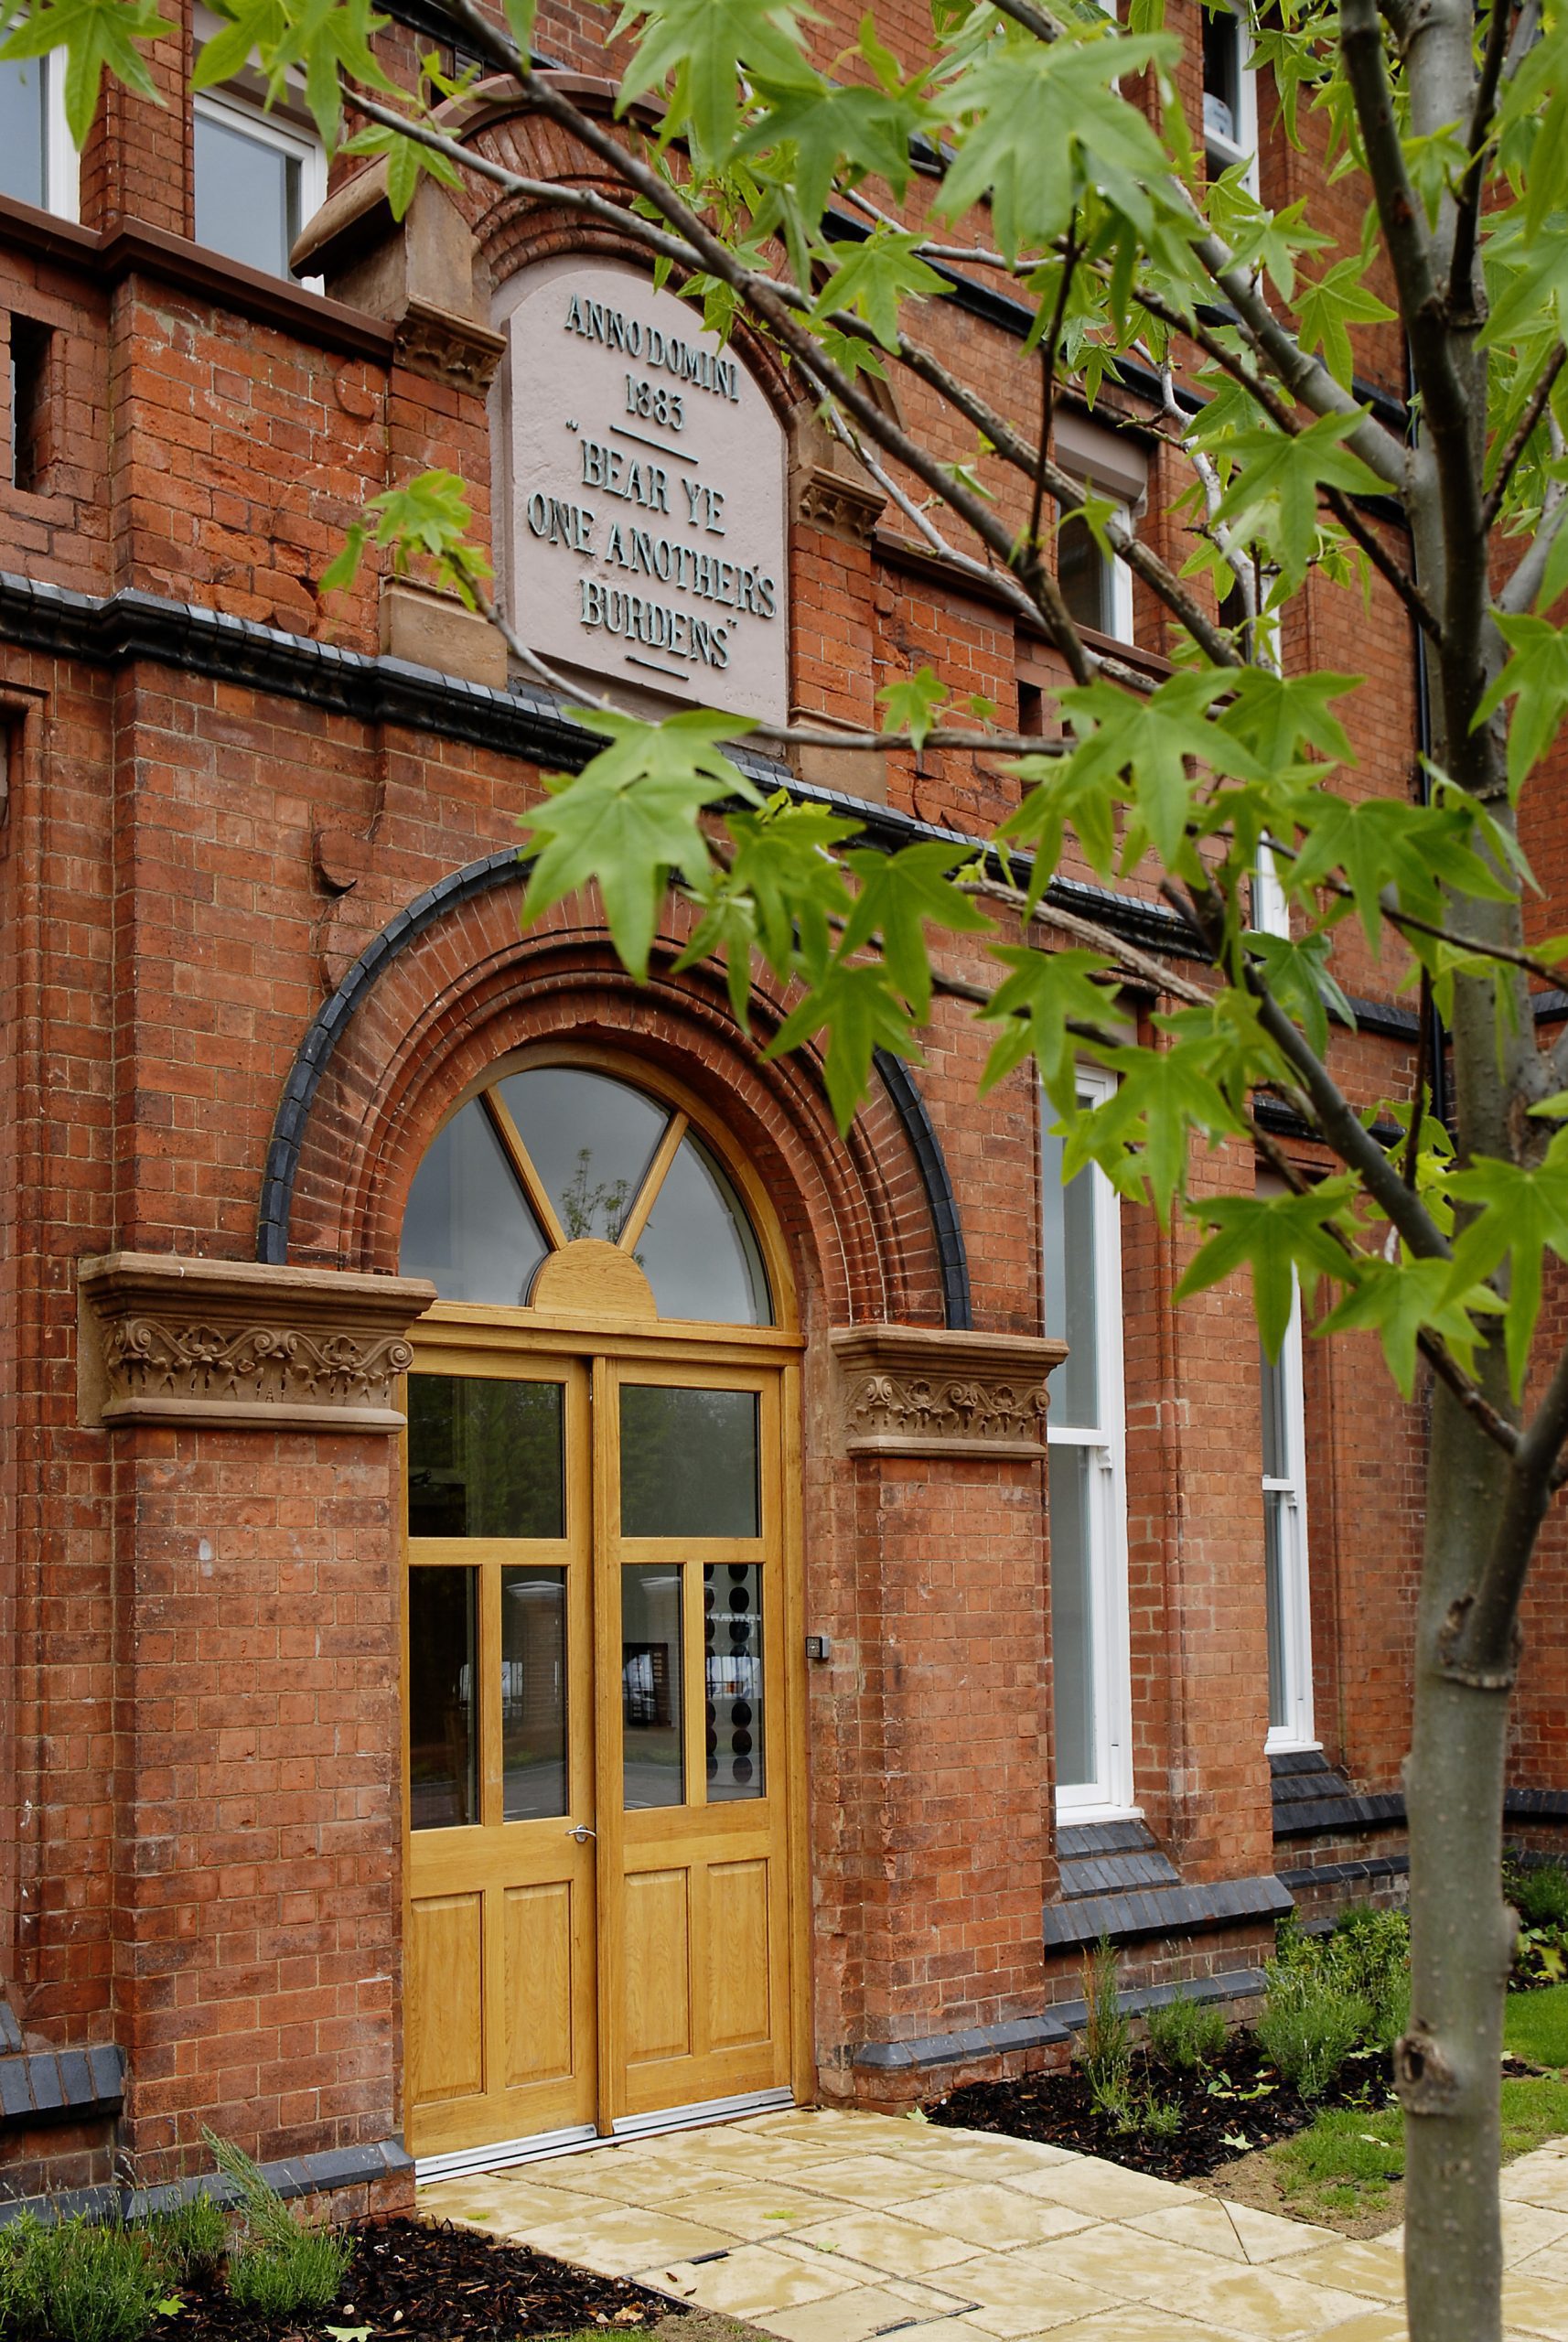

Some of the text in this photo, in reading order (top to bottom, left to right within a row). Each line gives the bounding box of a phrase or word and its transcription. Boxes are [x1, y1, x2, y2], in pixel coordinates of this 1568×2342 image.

[564, 294, 740, 403] ANNO DOMINI
[626, 373, 686, 431] 1883
[527, 492, 596, 556] ONE
[682, 478, 725, 535] YE
